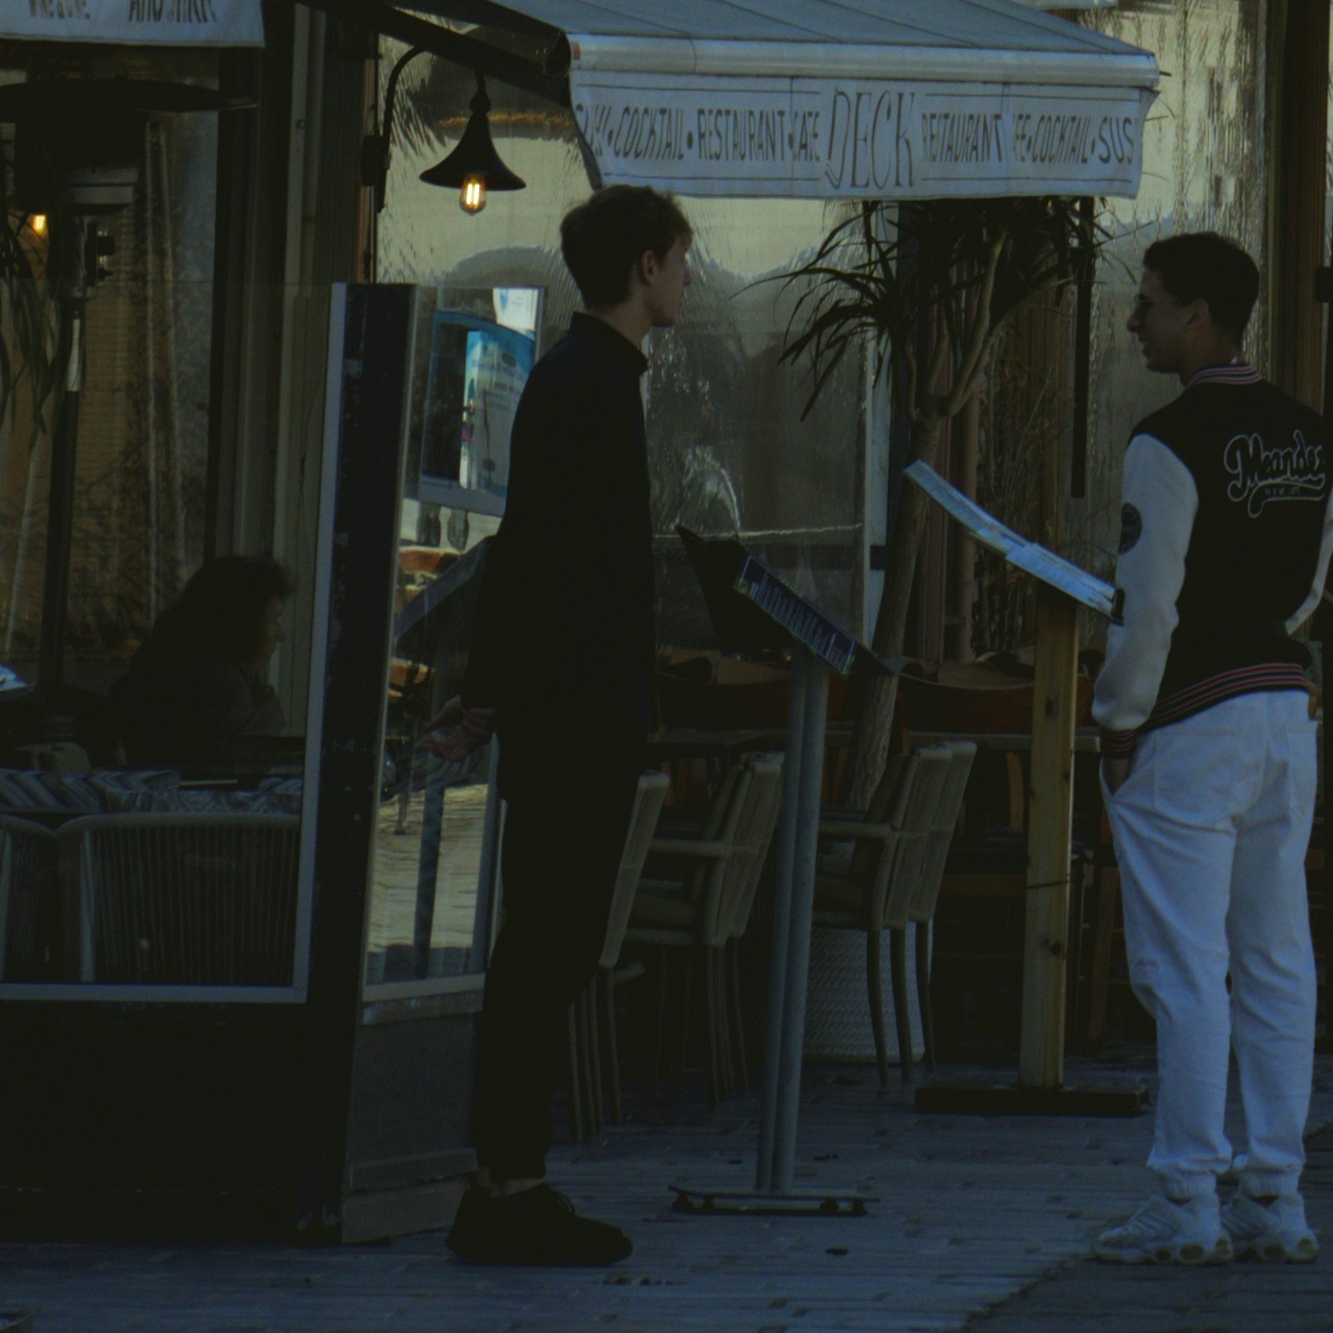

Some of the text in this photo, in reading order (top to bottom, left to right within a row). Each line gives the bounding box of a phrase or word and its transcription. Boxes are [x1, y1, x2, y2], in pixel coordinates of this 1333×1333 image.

[614, 106, 684, 160] COCKTAIL
[697, 108, 785, 162] RESTAURANT
[824, 87, 916, 190] DECK
[921, 112, 1002, 163] RESTAURANT
[1031, 113, 1091, 165] COCKTAIL
[1098, 115, 1137, 165] SUS
